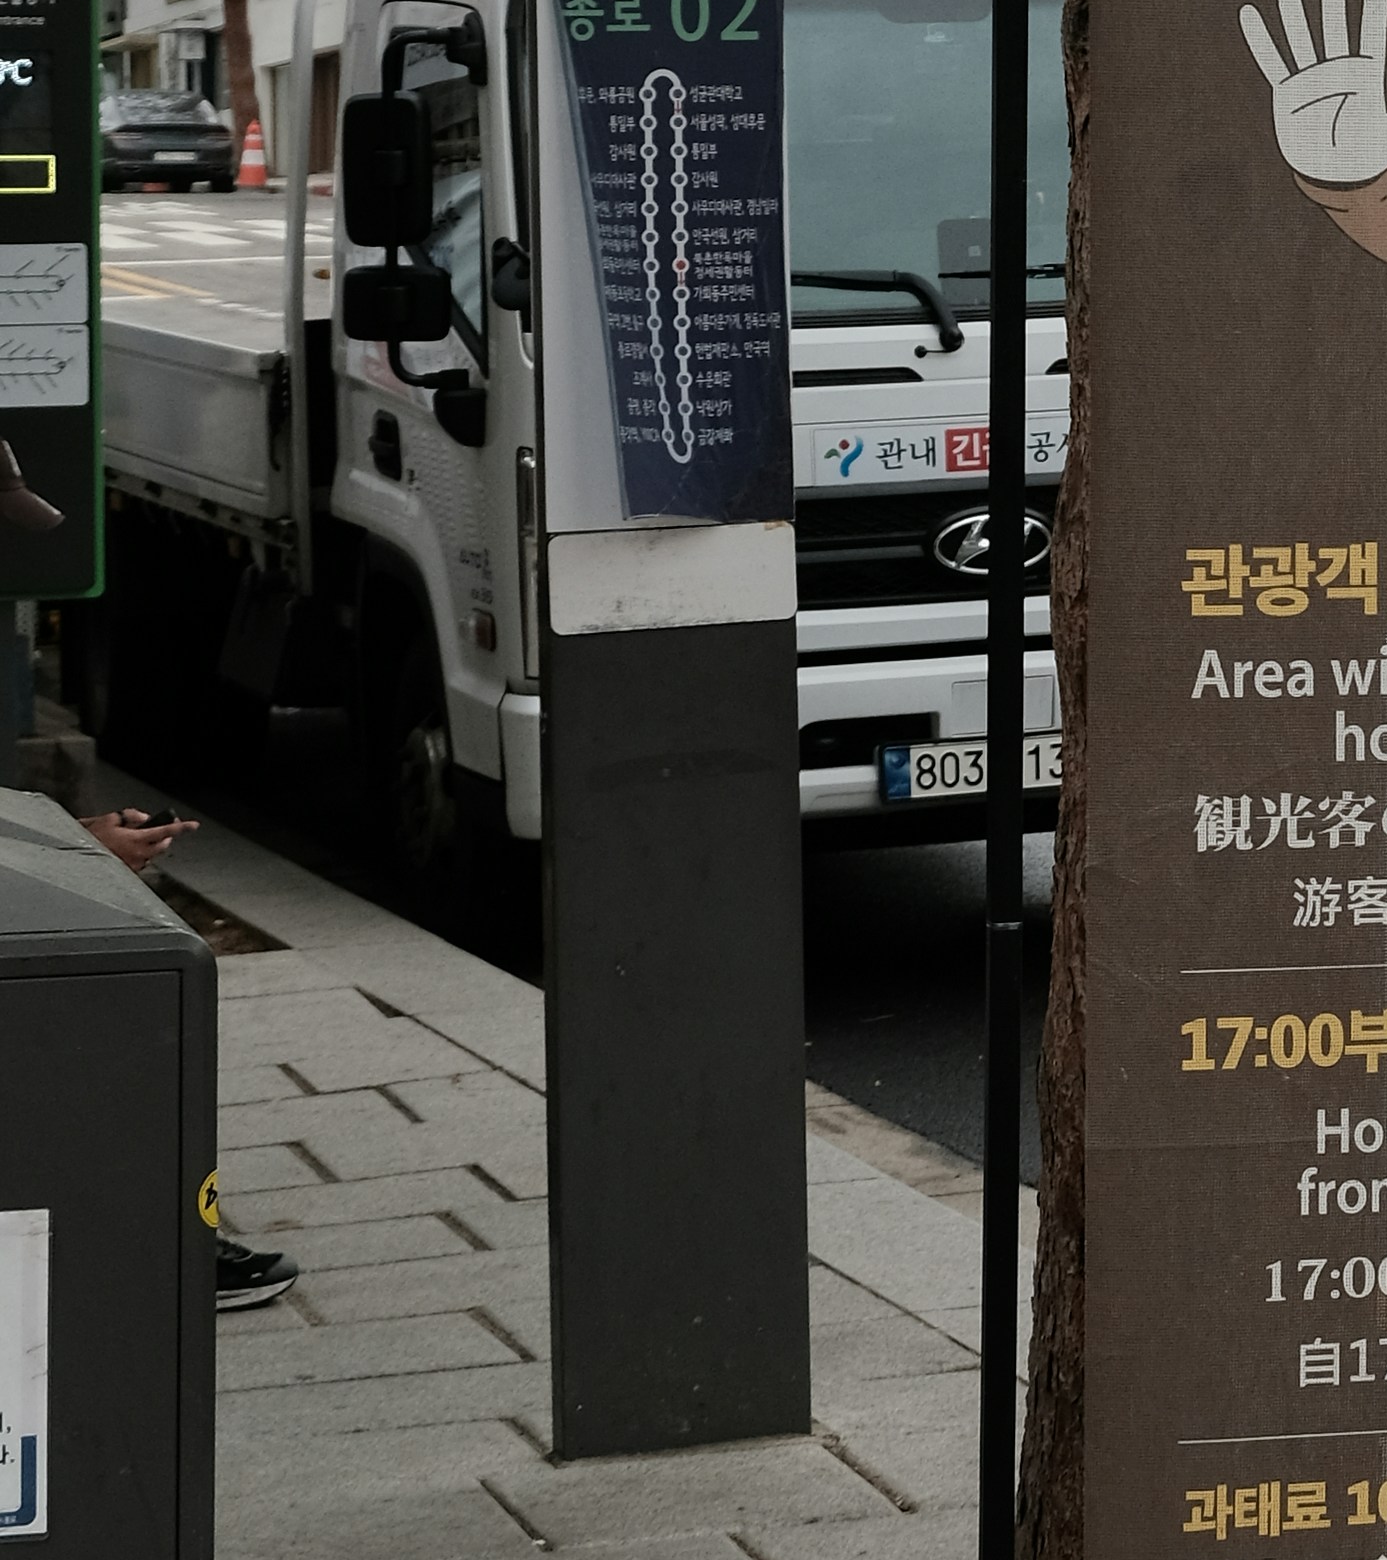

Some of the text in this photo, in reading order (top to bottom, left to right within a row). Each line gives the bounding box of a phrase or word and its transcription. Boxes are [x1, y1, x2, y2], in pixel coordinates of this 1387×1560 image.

[876, 431, 989, 470] 관내 긴
[1182, 542, 1377, 616] 관광객
[1191, 650, 1314, 698] Area
[1183, 1481, 1331, 1540] 과태료
